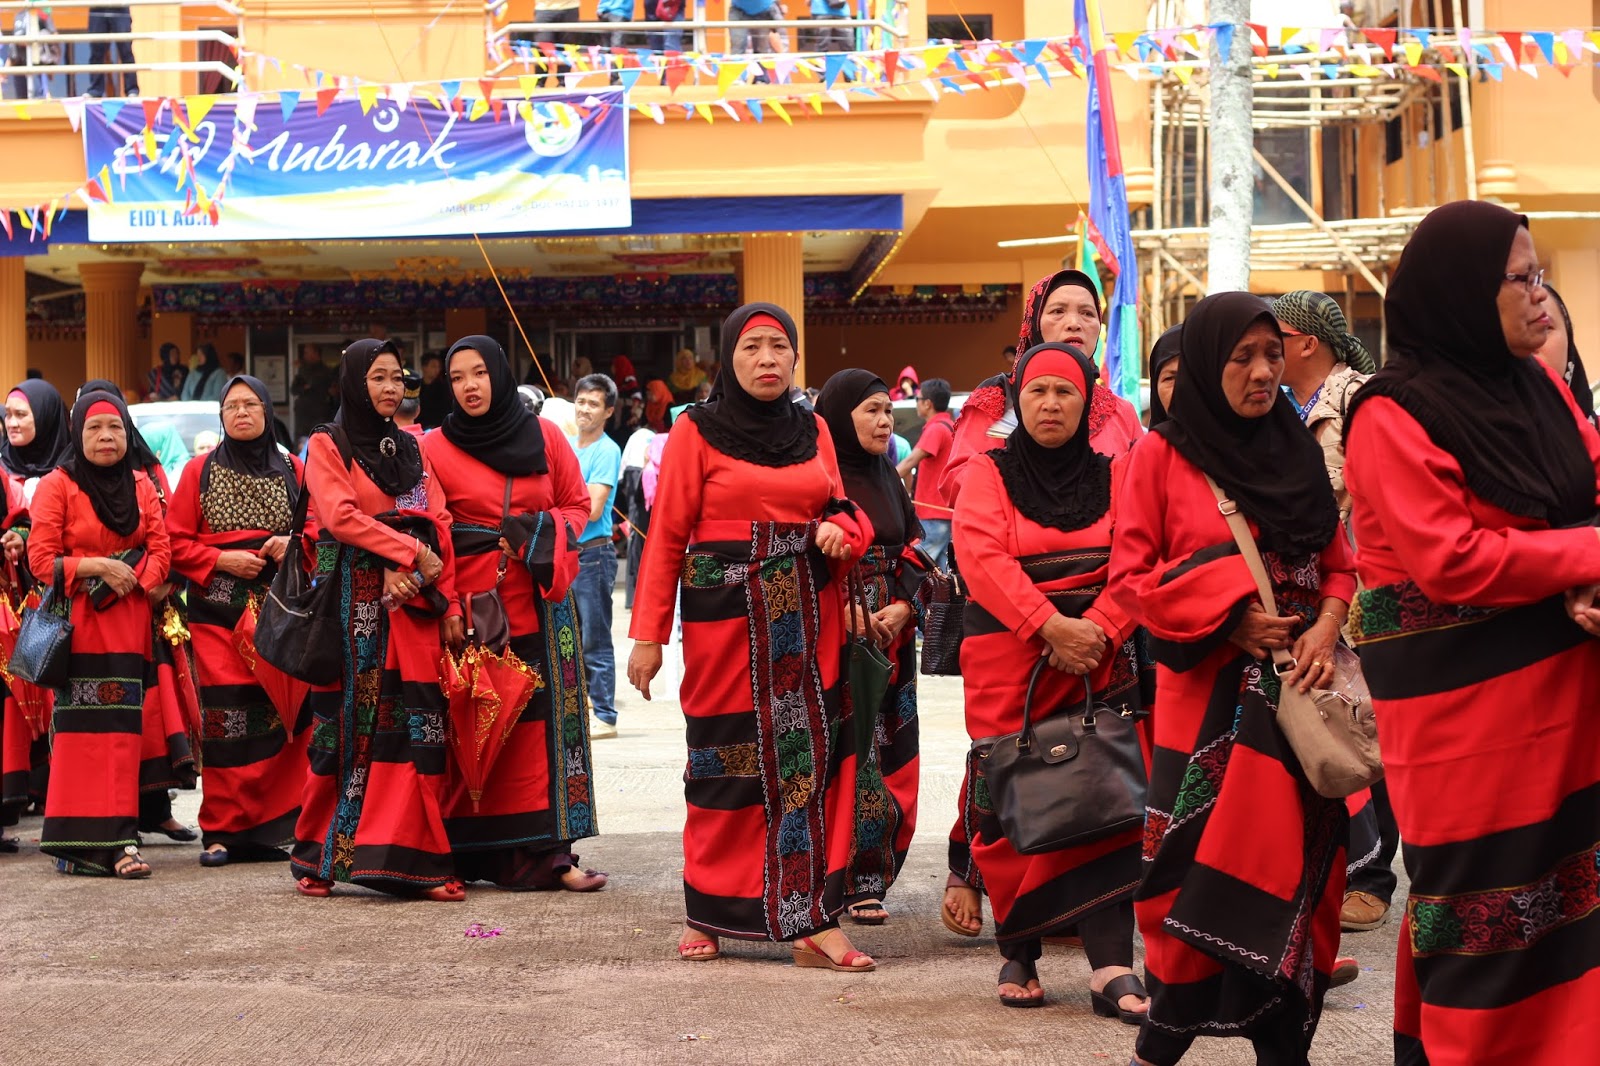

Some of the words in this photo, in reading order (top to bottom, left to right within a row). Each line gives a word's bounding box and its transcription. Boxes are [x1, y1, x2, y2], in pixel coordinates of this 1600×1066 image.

[217, 111, 458, 173] Mubarak
[129, 210, 168, 227] EID'L
[1303, 396, 1318, 413] CITY
